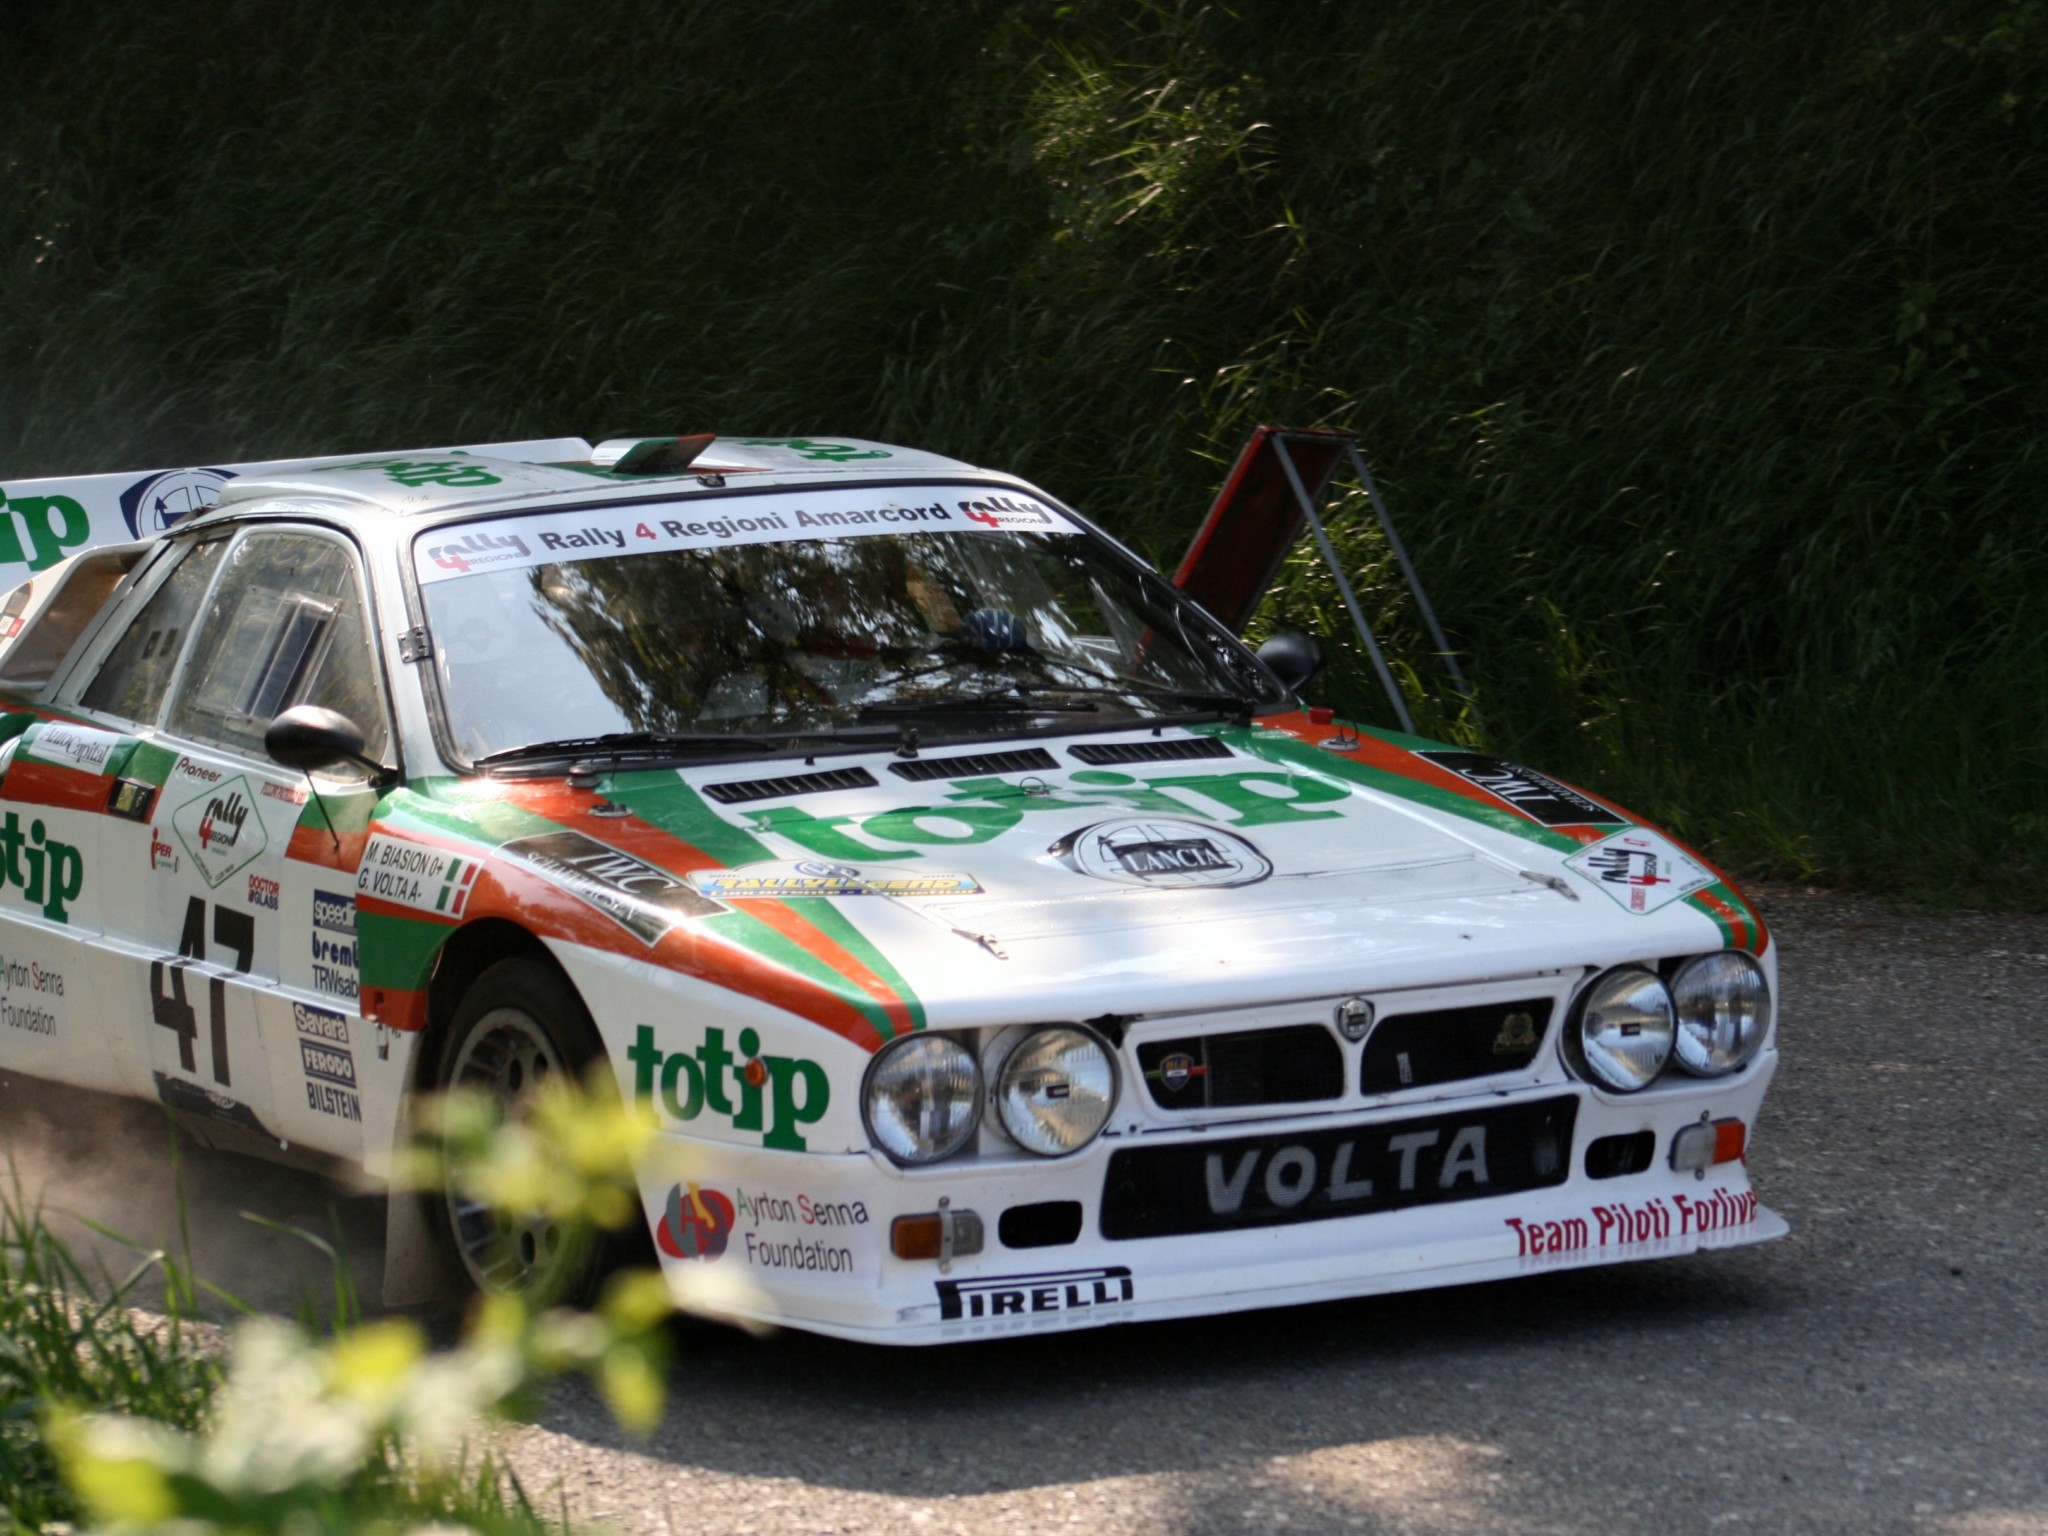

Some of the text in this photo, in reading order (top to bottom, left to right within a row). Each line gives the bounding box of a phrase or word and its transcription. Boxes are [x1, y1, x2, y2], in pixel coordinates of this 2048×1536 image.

[538, 503, 952, 551] Rally 4 Regioni Amarcord
[176, 756, 222, 783] Pioneer
[1458, 768, 1560, 803] IWC
[737, 770, 1352, 862] totip
[0, 811, 84, 925] tip
[365, 841, 380, 864] M.
[381, 844, 431, 877] BIASION
[564, 851, 680, 894] IWC
[1124, 848, 1225, 873] LANCIA
[249, 873, 280, 897] DOCTOR
[358, 867, 369, 890] G.
[372, 870, 408, 901] VOLTA
[32, 961, 64, 997] Senna
[150, 895, 255, 1088] 47
[1, 996, 57, 1037] Foundation
[303, 1047, 354, 1079] FERODO
[306, 1081, 362, 1123] BILSTEIN
[627, 1024, 830, 1152] totip
[1205, 1125, 1490, 1214] VOLTA
[737, 1187, 869, 1227] Ayrton Senna
[1504, 1217, 1588, 1256] Team
[1590, 1198, 1670, 1246] Piloti
[745, 1232, 854, 1273] Foundation
[934, 1265, 1134, 1321] PIRELLI
